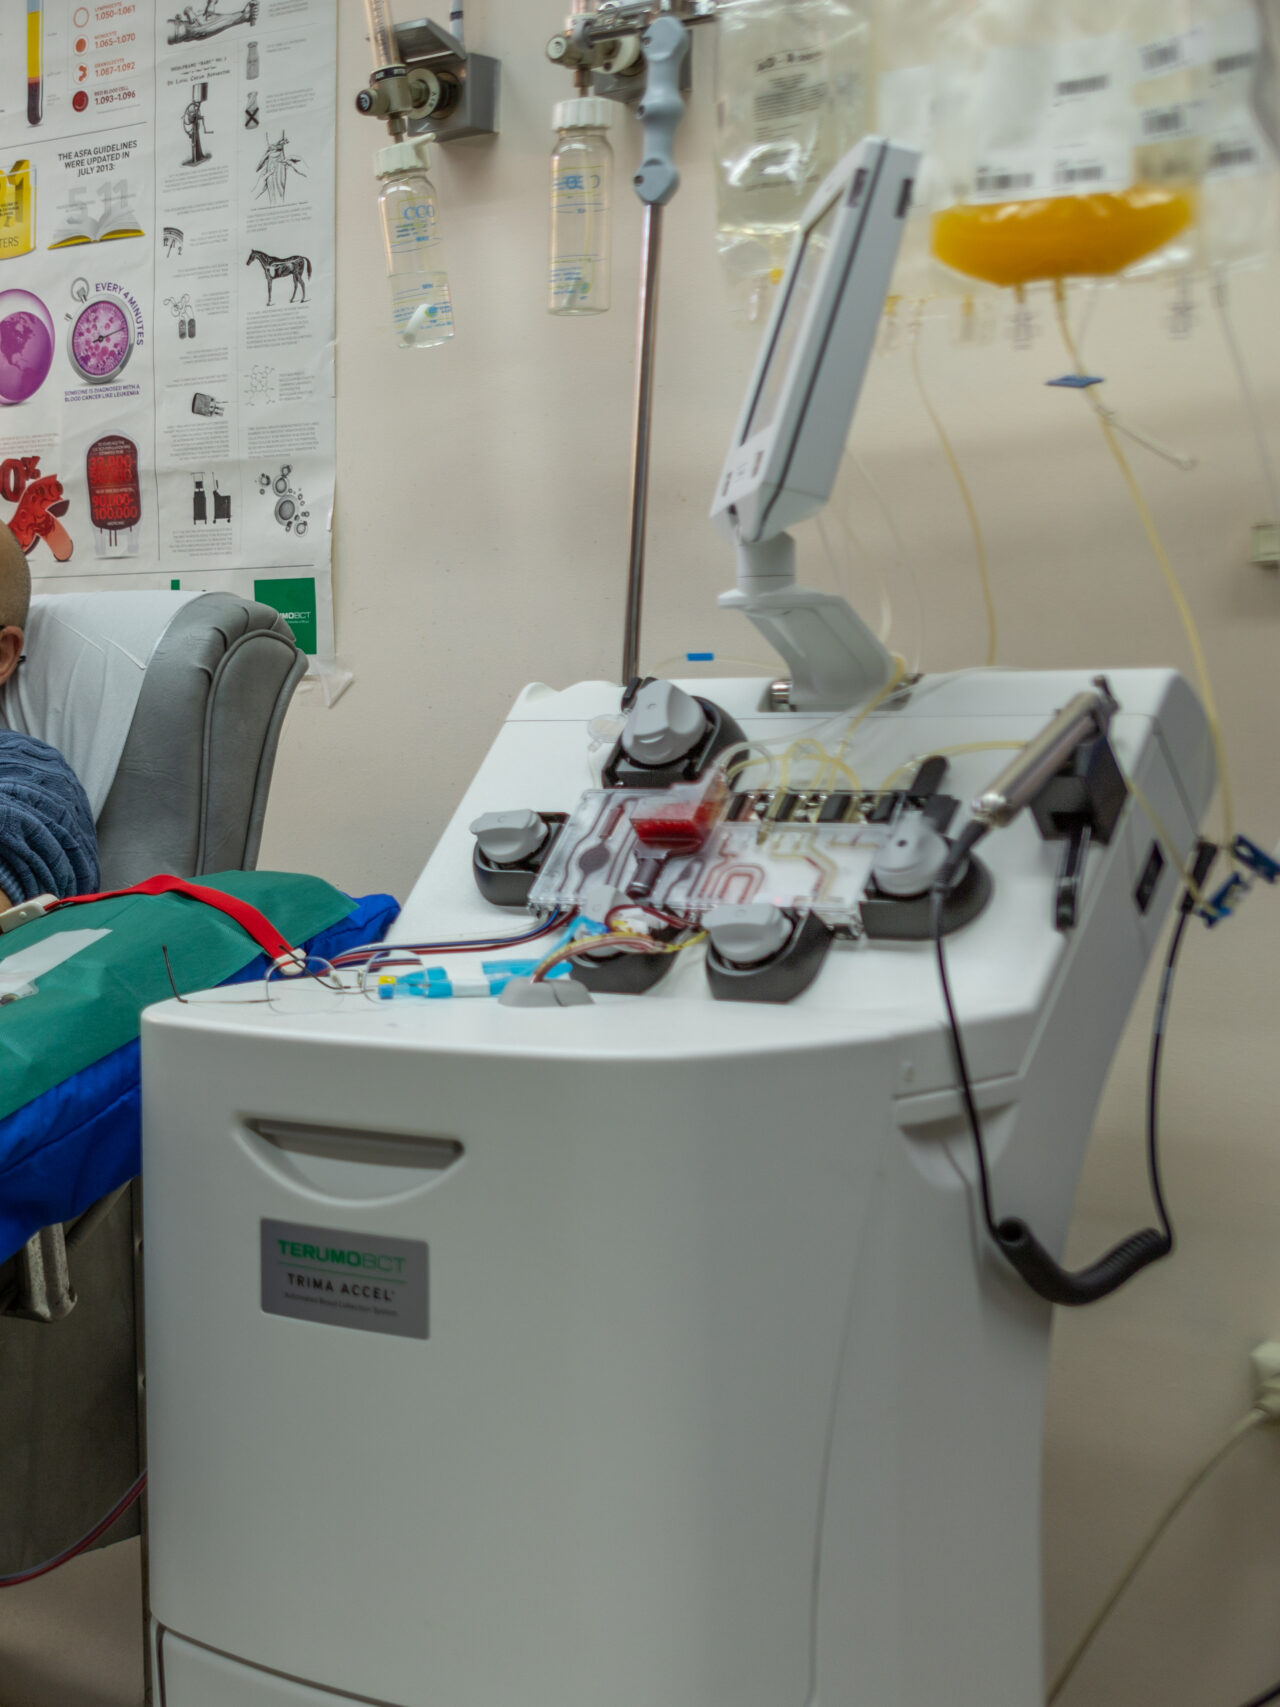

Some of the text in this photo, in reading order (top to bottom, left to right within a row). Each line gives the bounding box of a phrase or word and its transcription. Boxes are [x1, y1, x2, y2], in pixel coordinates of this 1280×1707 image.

[58, 140, 137, 161] THE ASFA GUIDELINES
[64, 151, 130, 169] WERE UPDATED IN
[77, 167, 95, 177] JULY
[95, 282, 144, 346] EVERY 4 MINUTES
[64, 388, 88, 396] SOMEONE
[113, 390, 139, 398] LEUKEMIA
[277, 1239, 408, 1273] TERUMOBCT
[287, 1273, 394, 1302] TRIMA ACCEL
